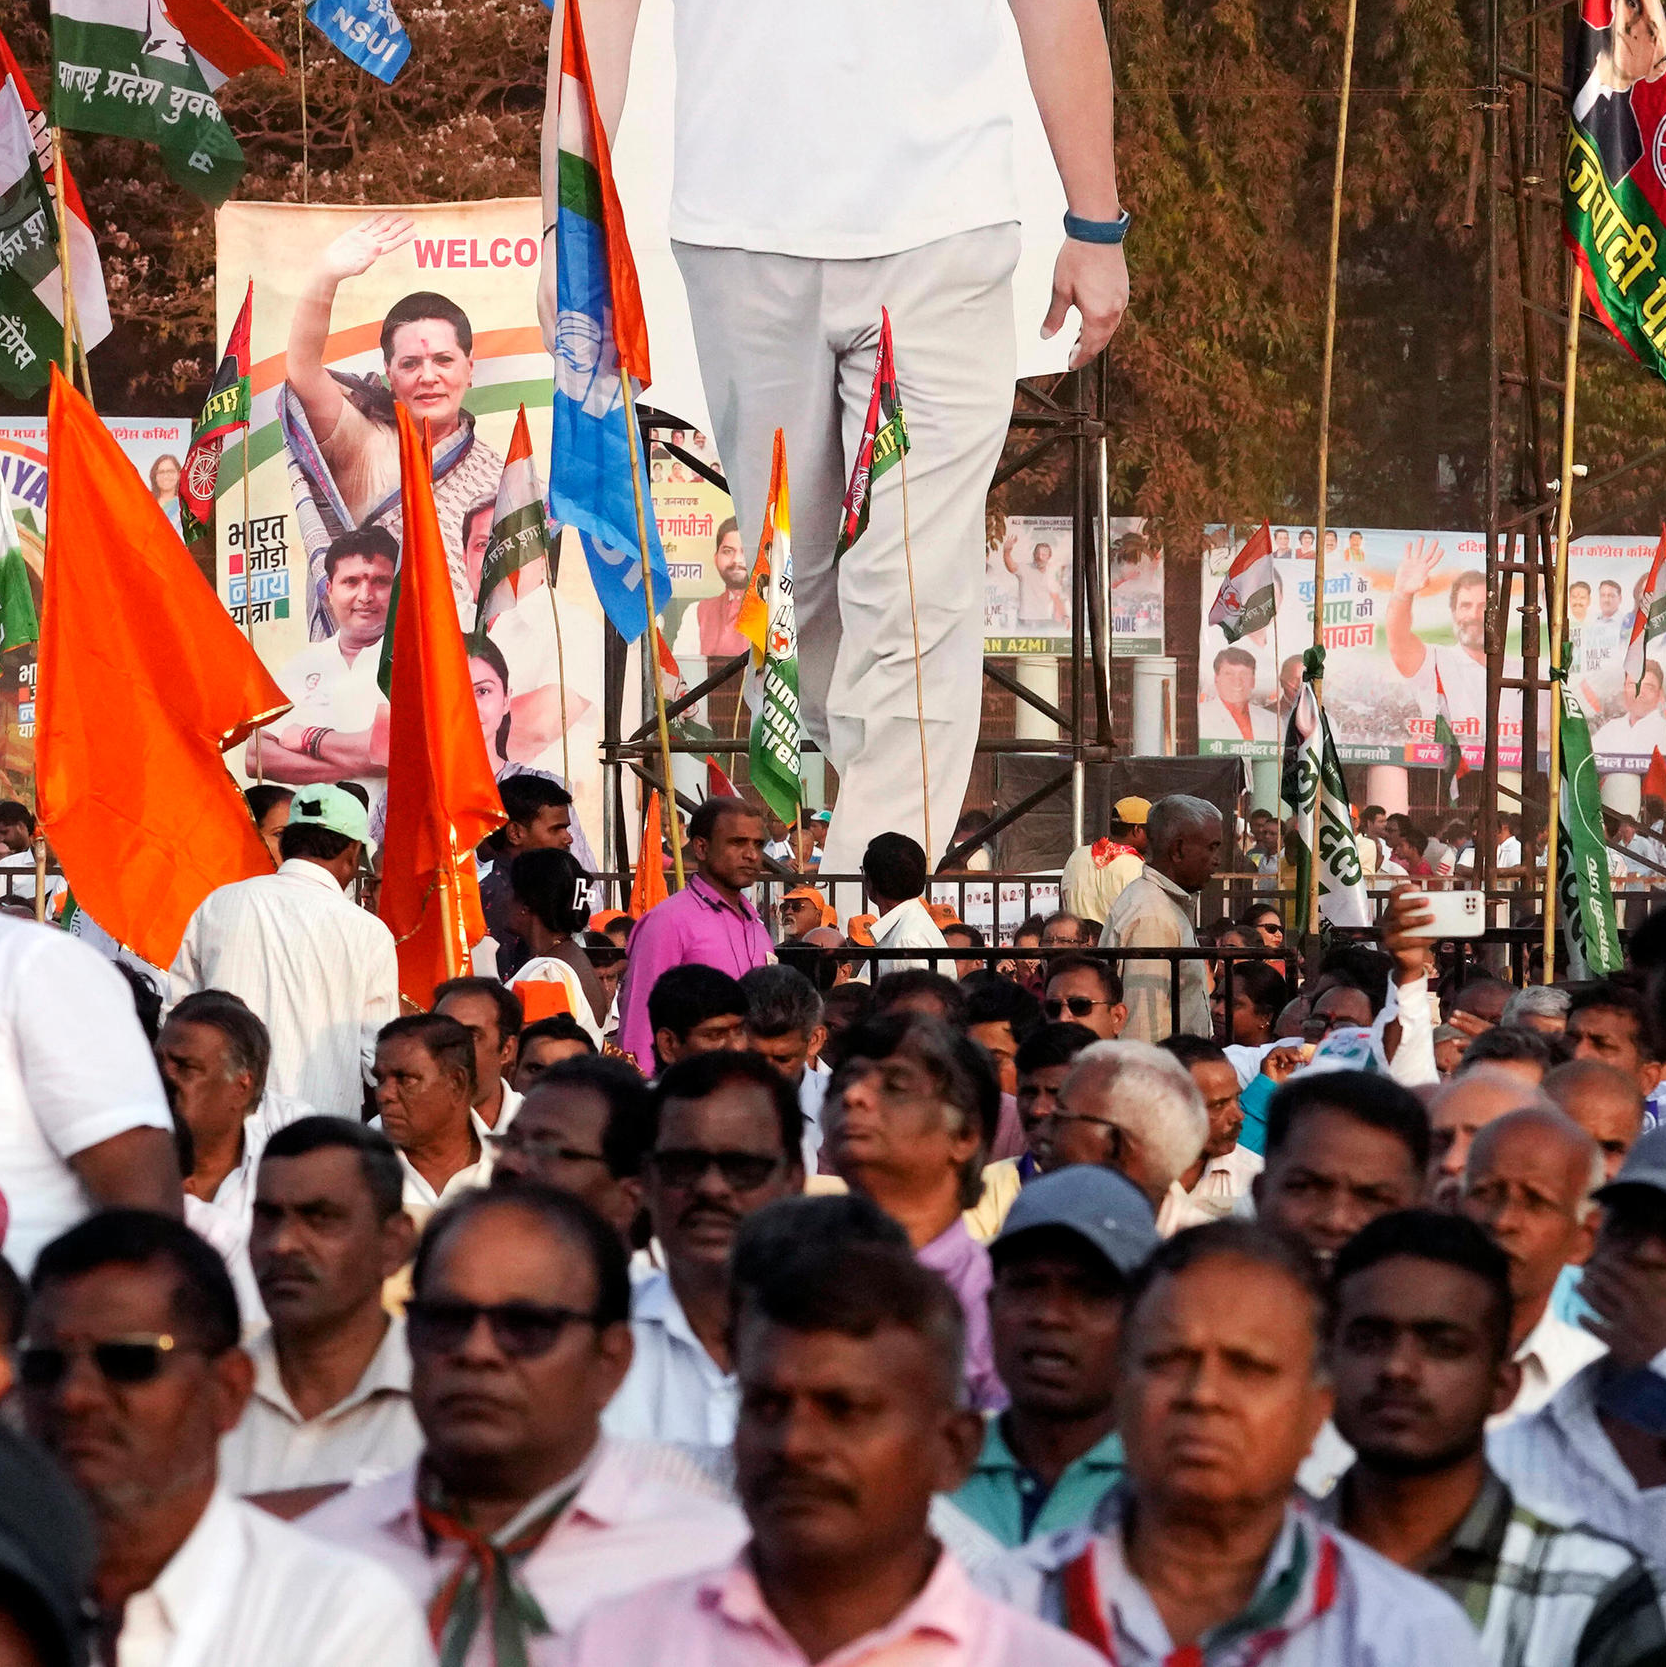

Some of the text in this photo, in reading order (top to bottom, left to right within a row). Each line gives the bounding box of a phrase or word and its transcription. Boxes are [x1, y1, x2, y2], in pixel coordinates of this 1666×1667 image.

[332, 6, 400, 63] NSUI
[103, 63, 164, 106] प्रदेश
[161, 85, 222, 125] युवक
[414, 237, 544, 269] WELCO
[229, 514, 288, 550] भारत
[667, 513, 713, 537] गांधीजी
[667, 563, 702, 580] वागत
[230, 569, 289, 605] न्याय
[1357, 577, 1368, 594] के
[230, 600, 271, 627] यात्रा
[1356, 598, 1374, 617] की
[1007, 638, 1047, 652] AZMI
